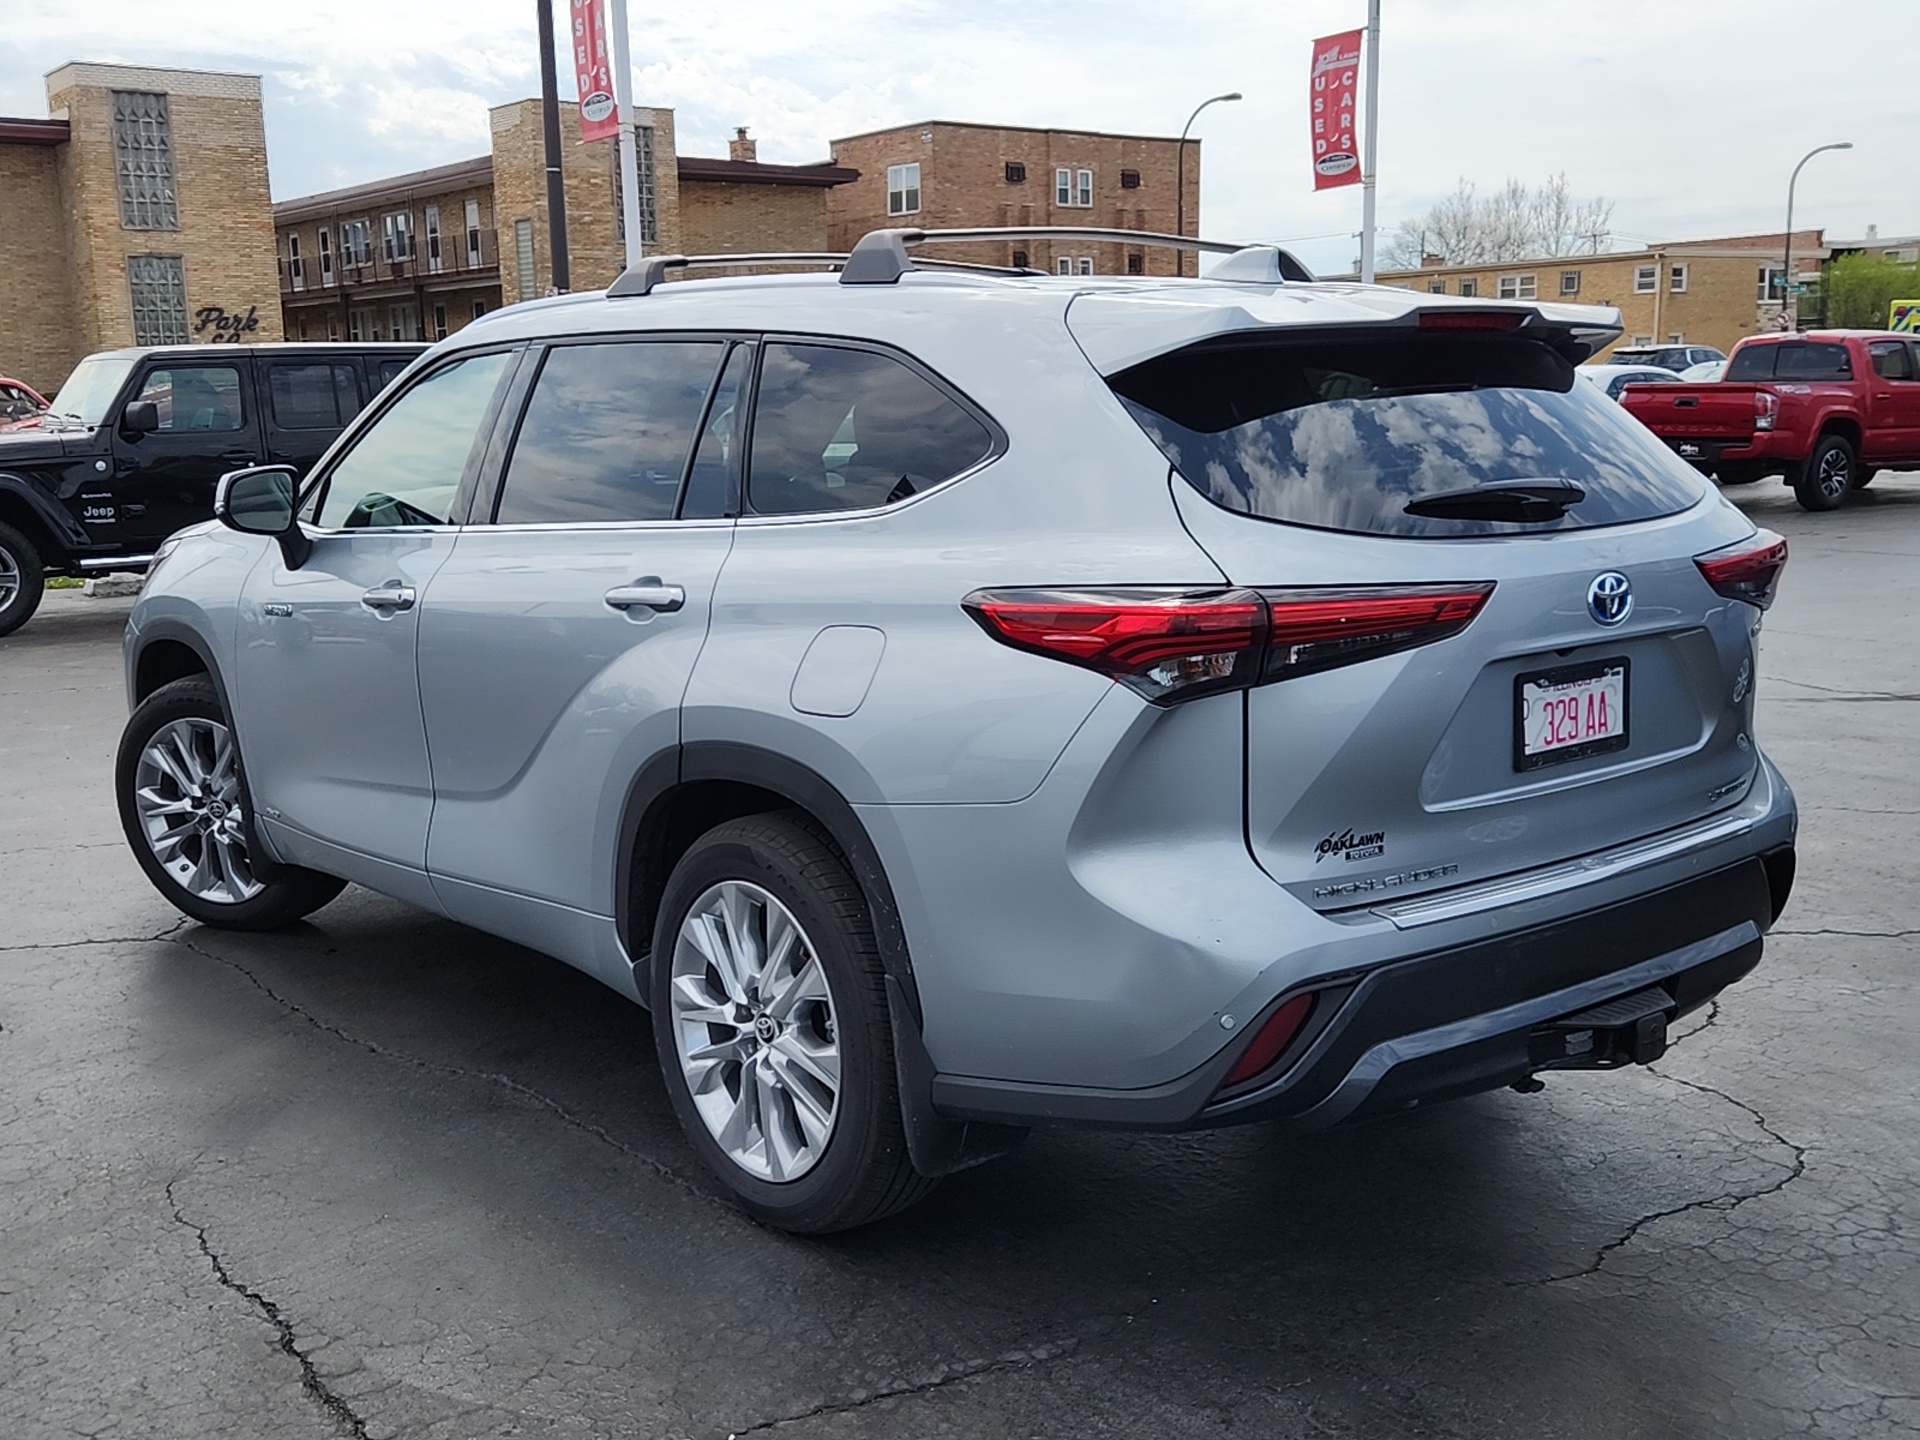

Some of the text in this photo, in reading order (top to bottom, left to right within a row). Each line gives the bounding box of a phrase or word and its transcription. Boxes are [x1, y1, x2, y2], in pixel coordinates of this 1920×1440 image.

[595, 11, 607, 86] ARS
[1314, 77, 1326, 153] USED
[1341, 72, 1353, 149] CARS
[194, 305, 259, 332] Park
[83, 505, 115, 517] Jeep
[1543, 697, 1579, 745] 329
[1587, 691, 1608, 737] AA
[1349, 846, 1380, 859] TOYOTA
[1314, 864, 1458, 898] HIGHLANDER
